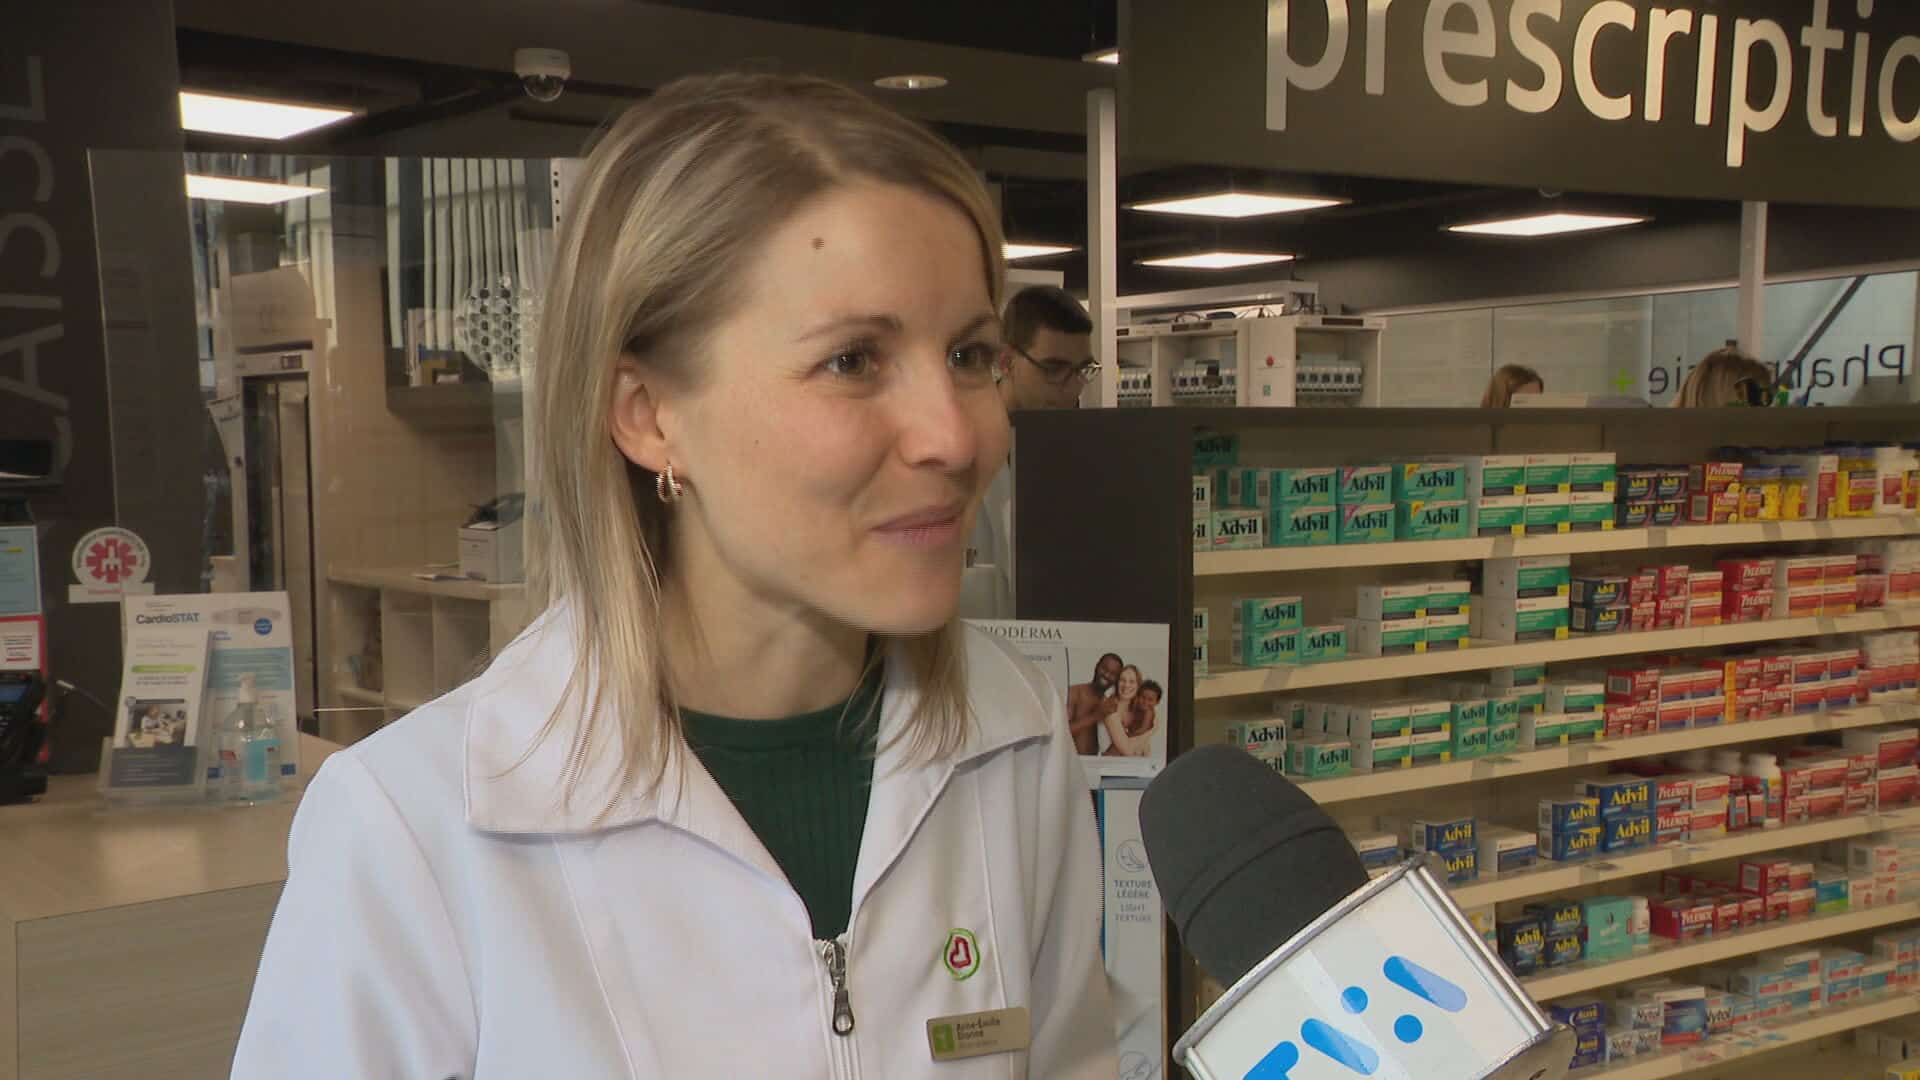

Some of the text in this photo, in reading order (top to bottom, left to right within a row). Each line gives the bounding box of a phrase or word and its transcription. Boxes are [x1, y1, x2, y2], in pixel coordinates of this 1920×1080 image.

[1289, 476, 1329, 494] Advil
[1350, 475, 1385, 491] Advil
[1416, 472, 1455, 488] Advil
[1289, 515, 1329, 532] Advil
[1352, 513, 1388, 529] Advil
[1422, 509, 1459, 525] Advil
[1218, 519, 1257, 536] Advil
[135, 612, 201, 625] CardioSTAT
[1261, 605, 1297, 621] Advil
[1261, 637, 1296, 654] Advil
[1307, 634, 1341, 649] Advil
[1247, 726, 1284, 743] Advil
[1317, 748, 1350, 766] Advil
[1612, 784, 1649, 806] Advil
[1569, 806, 1597, 822] Advil
[1444, 824, 1473, 841] Advil
[1616, 817, 1651, 840] Advil
[1569, 833, 1598, 850] Advil
[1514, 927, 1542, 946] Advil
